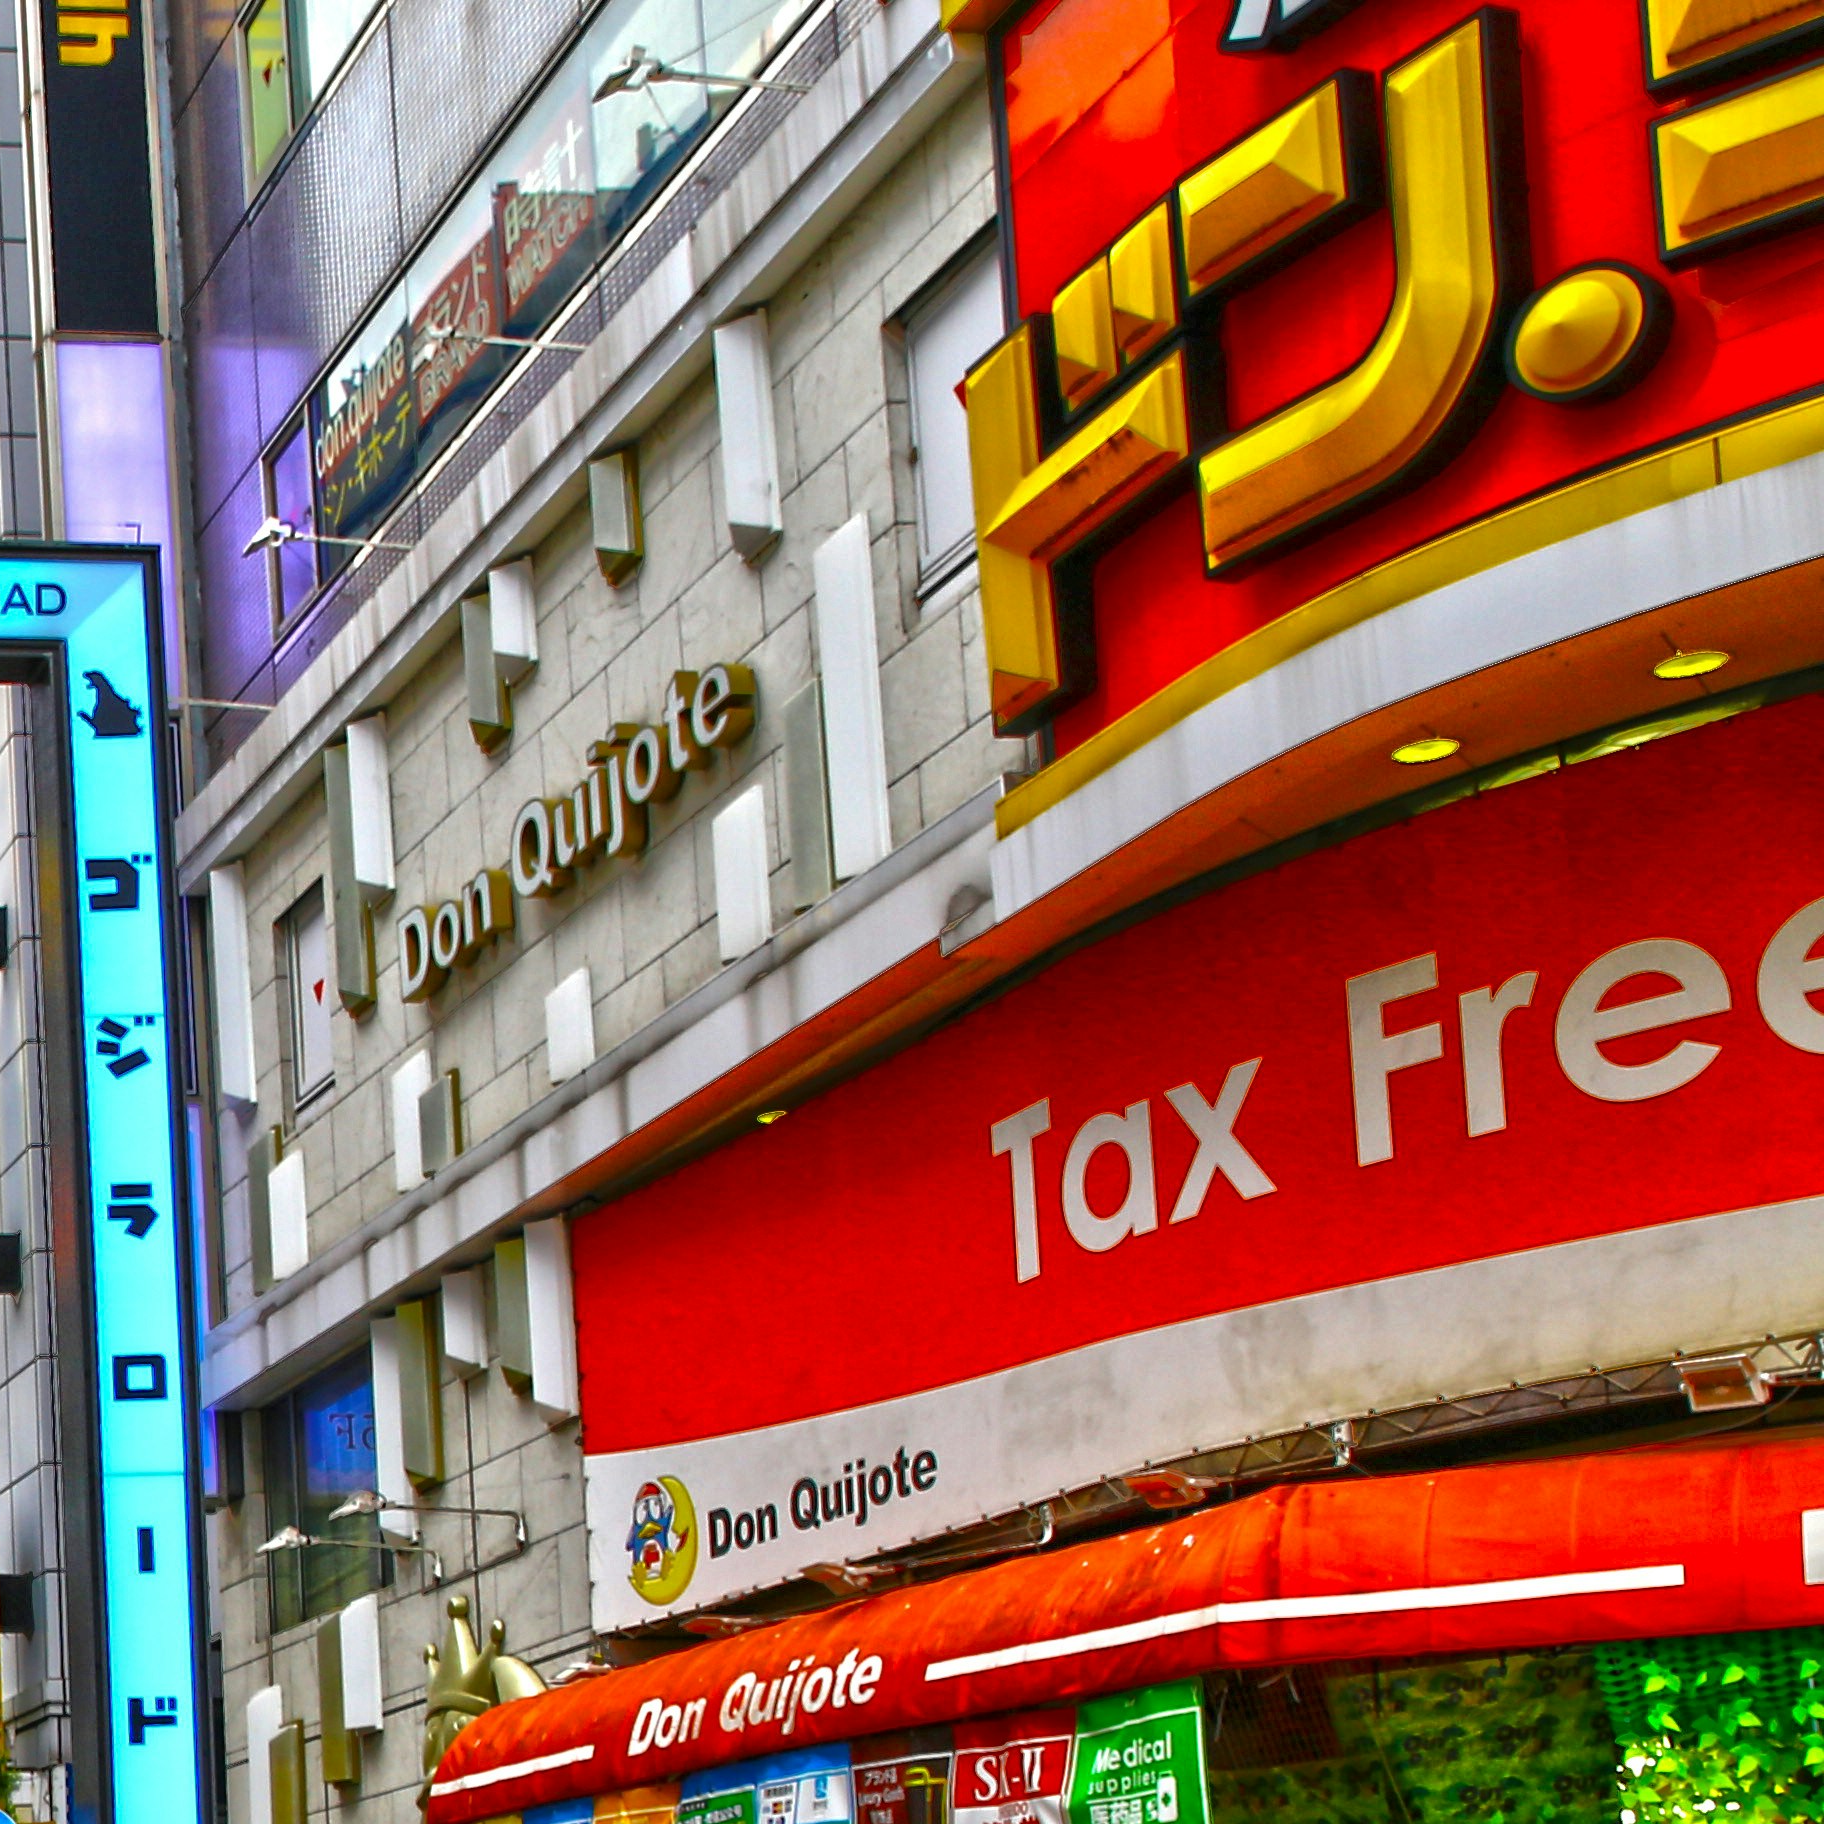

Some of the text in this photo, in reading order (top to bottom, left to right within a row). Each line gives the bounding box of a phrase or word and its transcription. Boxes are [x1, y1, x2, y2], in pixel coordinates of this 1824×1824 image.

[397, 662, 749, 1003] Don Quijote
[991, 1056, 1279, 1284] Tax
[86, 853, 179, 1747] ゴジラロード
[708, 1446, 940, 1561] Don Quijote
[628, 1649, 884, 1757] Don Quijote
[1091, 1731, 1173, 1776] Medical
[1087, 1771, 1159, 1796] supplies
